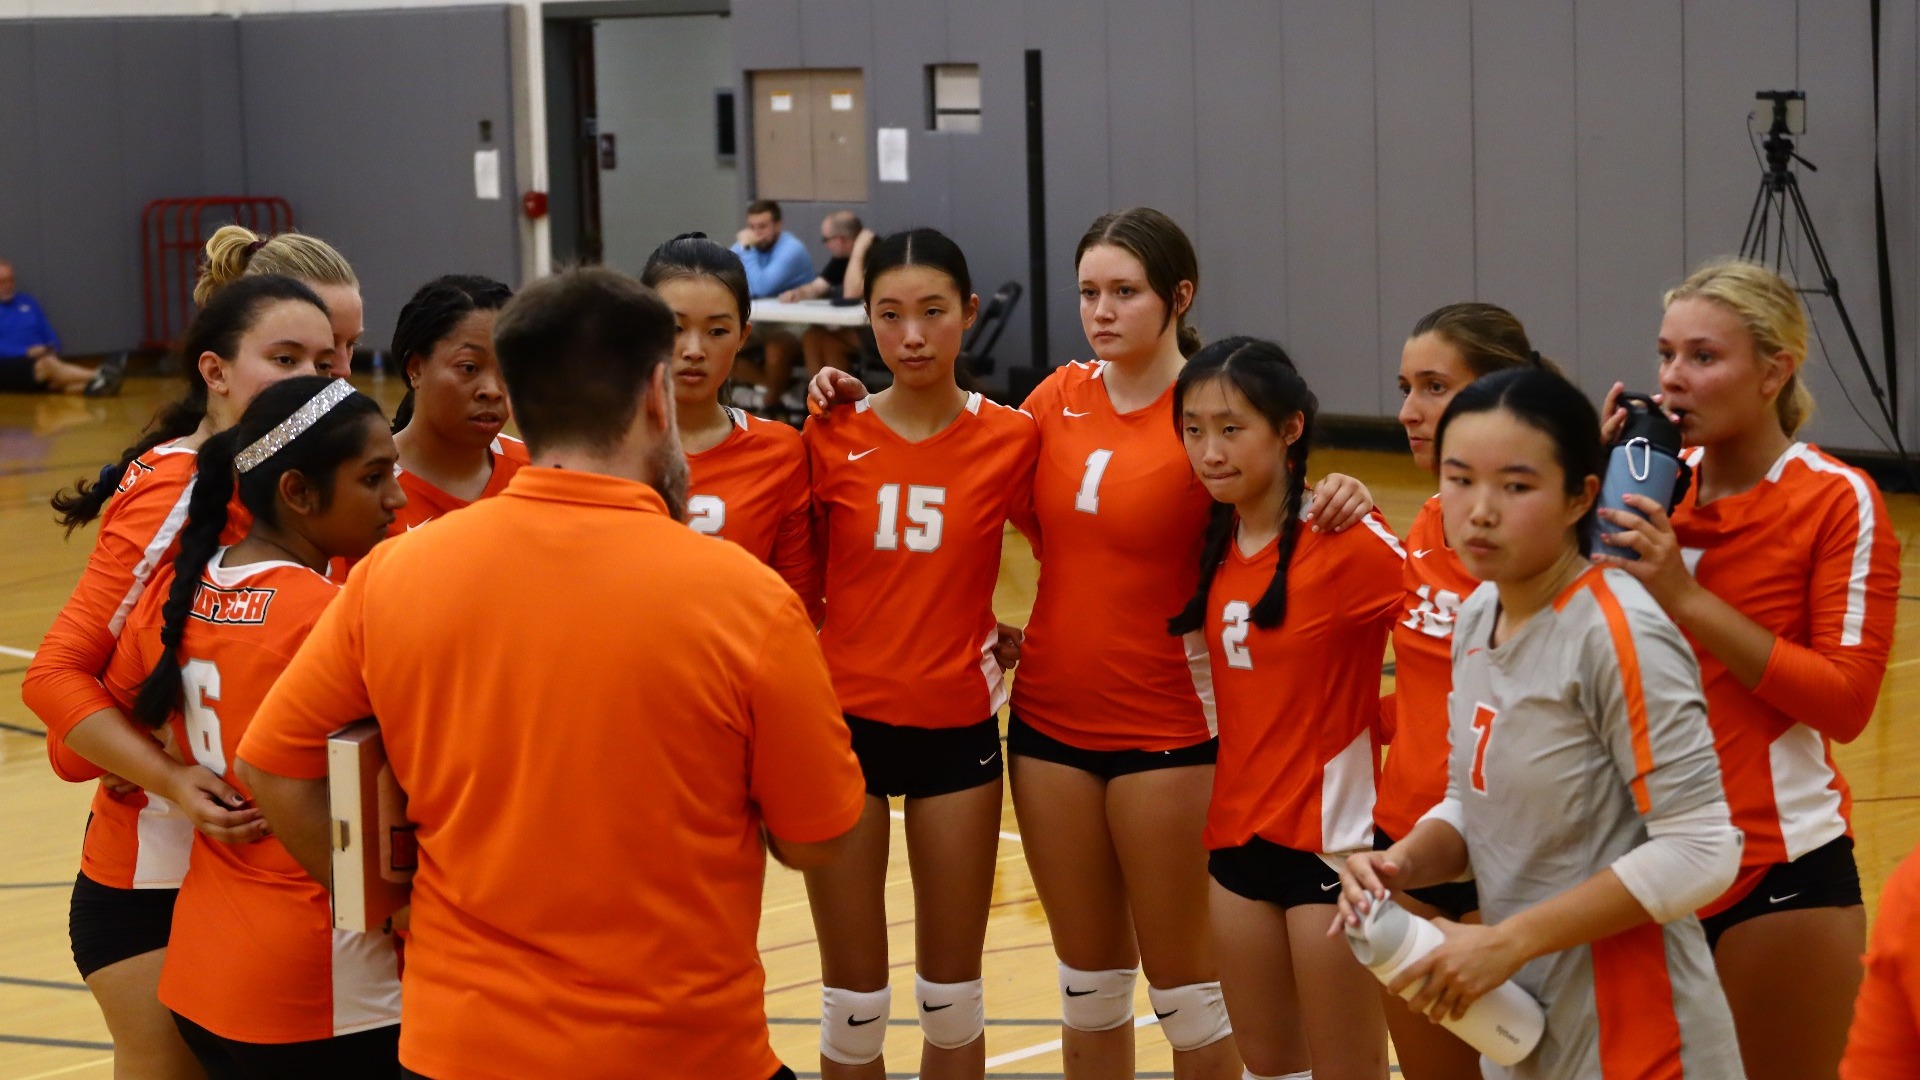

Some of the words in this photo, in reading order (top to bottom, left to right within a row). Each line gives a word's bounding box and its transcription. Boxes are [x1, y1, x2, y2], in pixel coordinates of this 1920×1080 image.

[1075, 448, 1114, 515] 1
[874, 483, 946, 553] 15
[1221, 599, 1254, 671] 2
[180, 658, 228, 778] 6
[1469, 701, 1499, 796] 7
